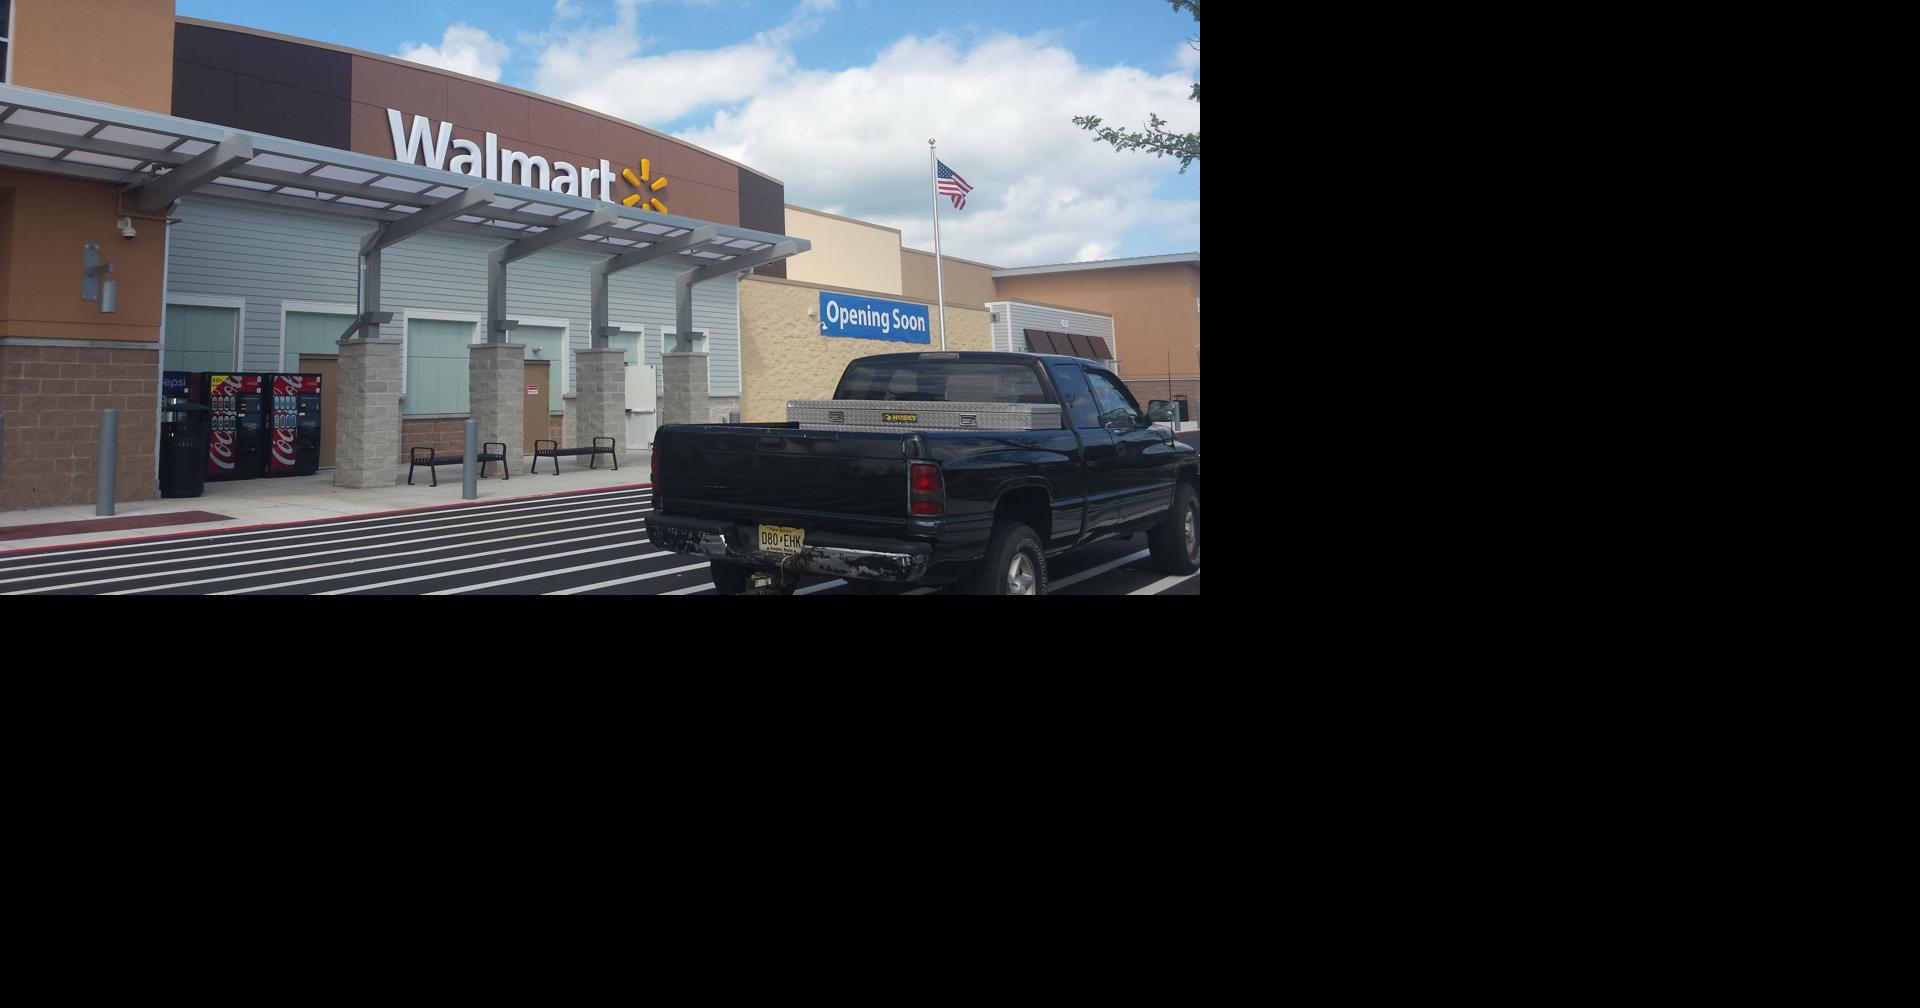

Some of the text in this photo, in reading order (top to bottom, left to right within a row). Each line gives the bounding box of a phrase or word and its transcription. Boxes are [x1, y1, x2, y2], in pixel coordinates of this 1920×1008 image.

[386, 108, 616, 204] Walmart
[826, 300, 925, 334] Opening Soon
[163, 377, 186, 390] epsi
[762, 531, 801, 548] D80 EHK
